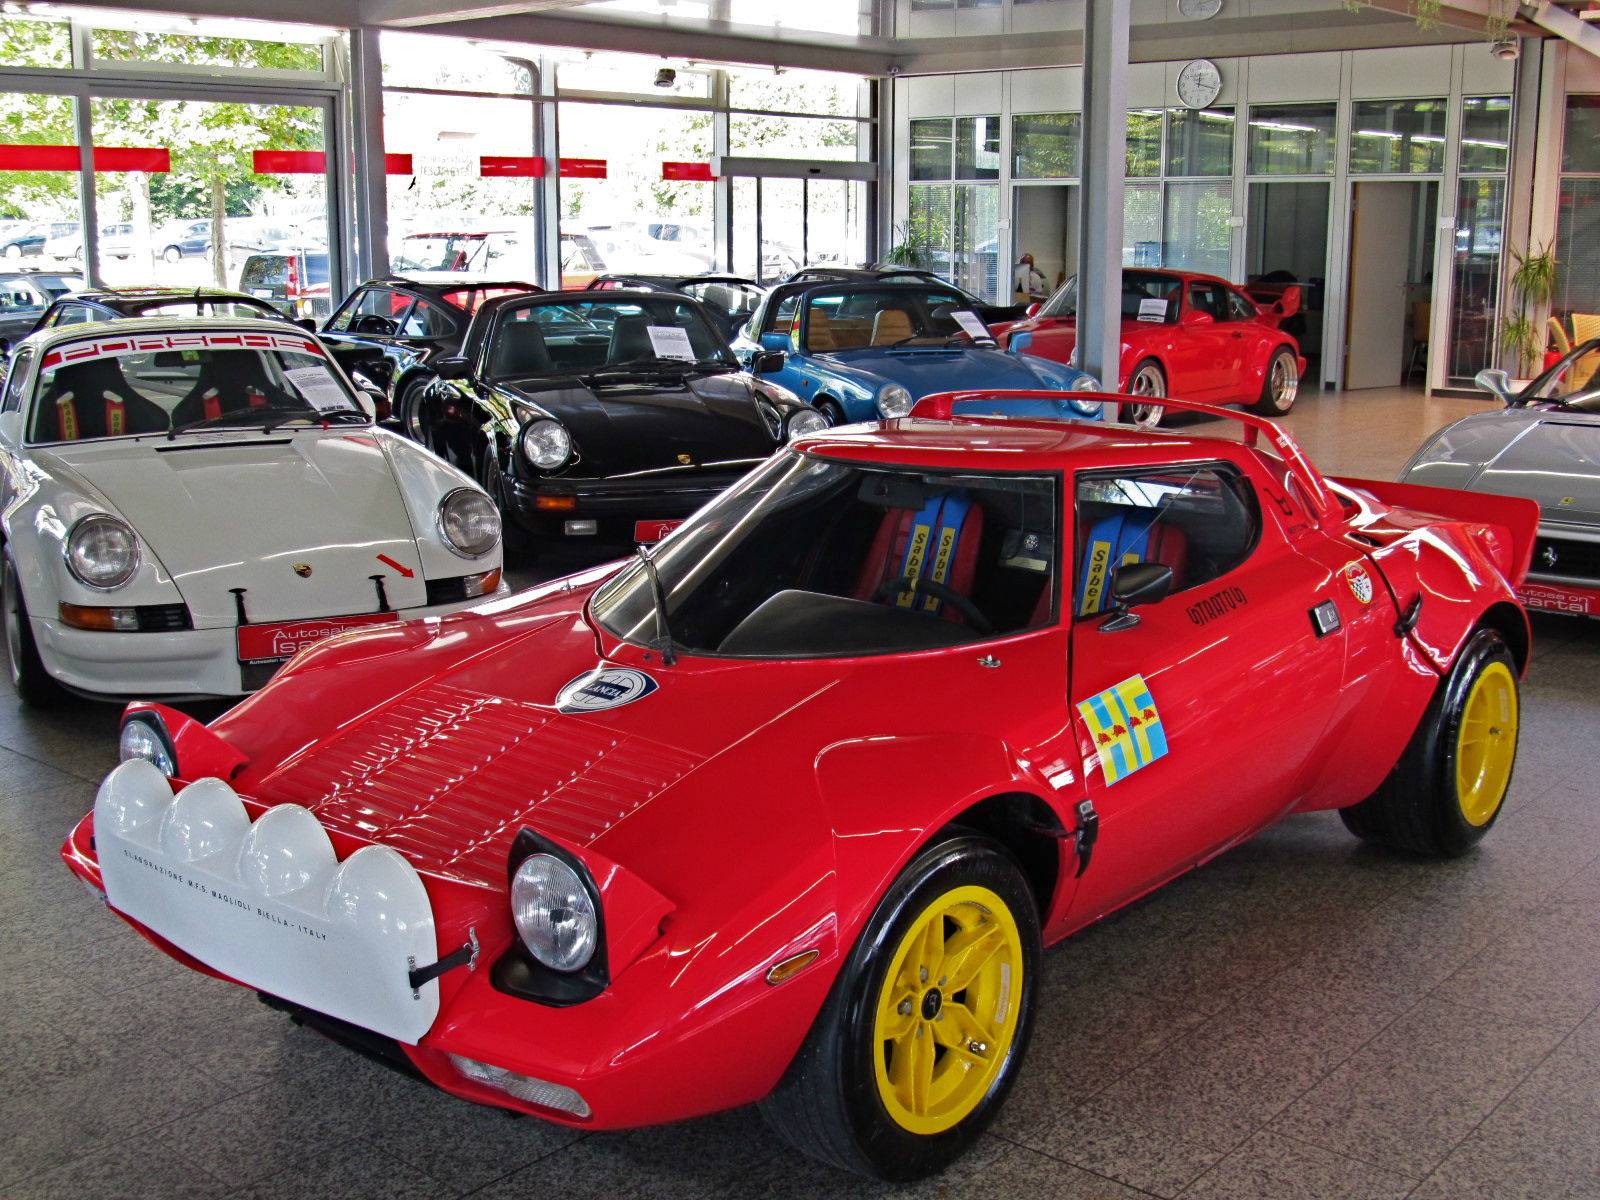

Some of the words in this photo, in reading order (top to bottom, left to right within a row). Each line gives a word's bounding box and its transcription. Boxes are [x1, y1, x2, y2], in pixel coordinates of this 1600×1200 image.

[61, 335, 305, 361] PORSCHE
[1086, 549, 1106, 610] Sabel
[1518, 595, 1589, 613] sartal
[1080, 677, 1162, 783] HF
